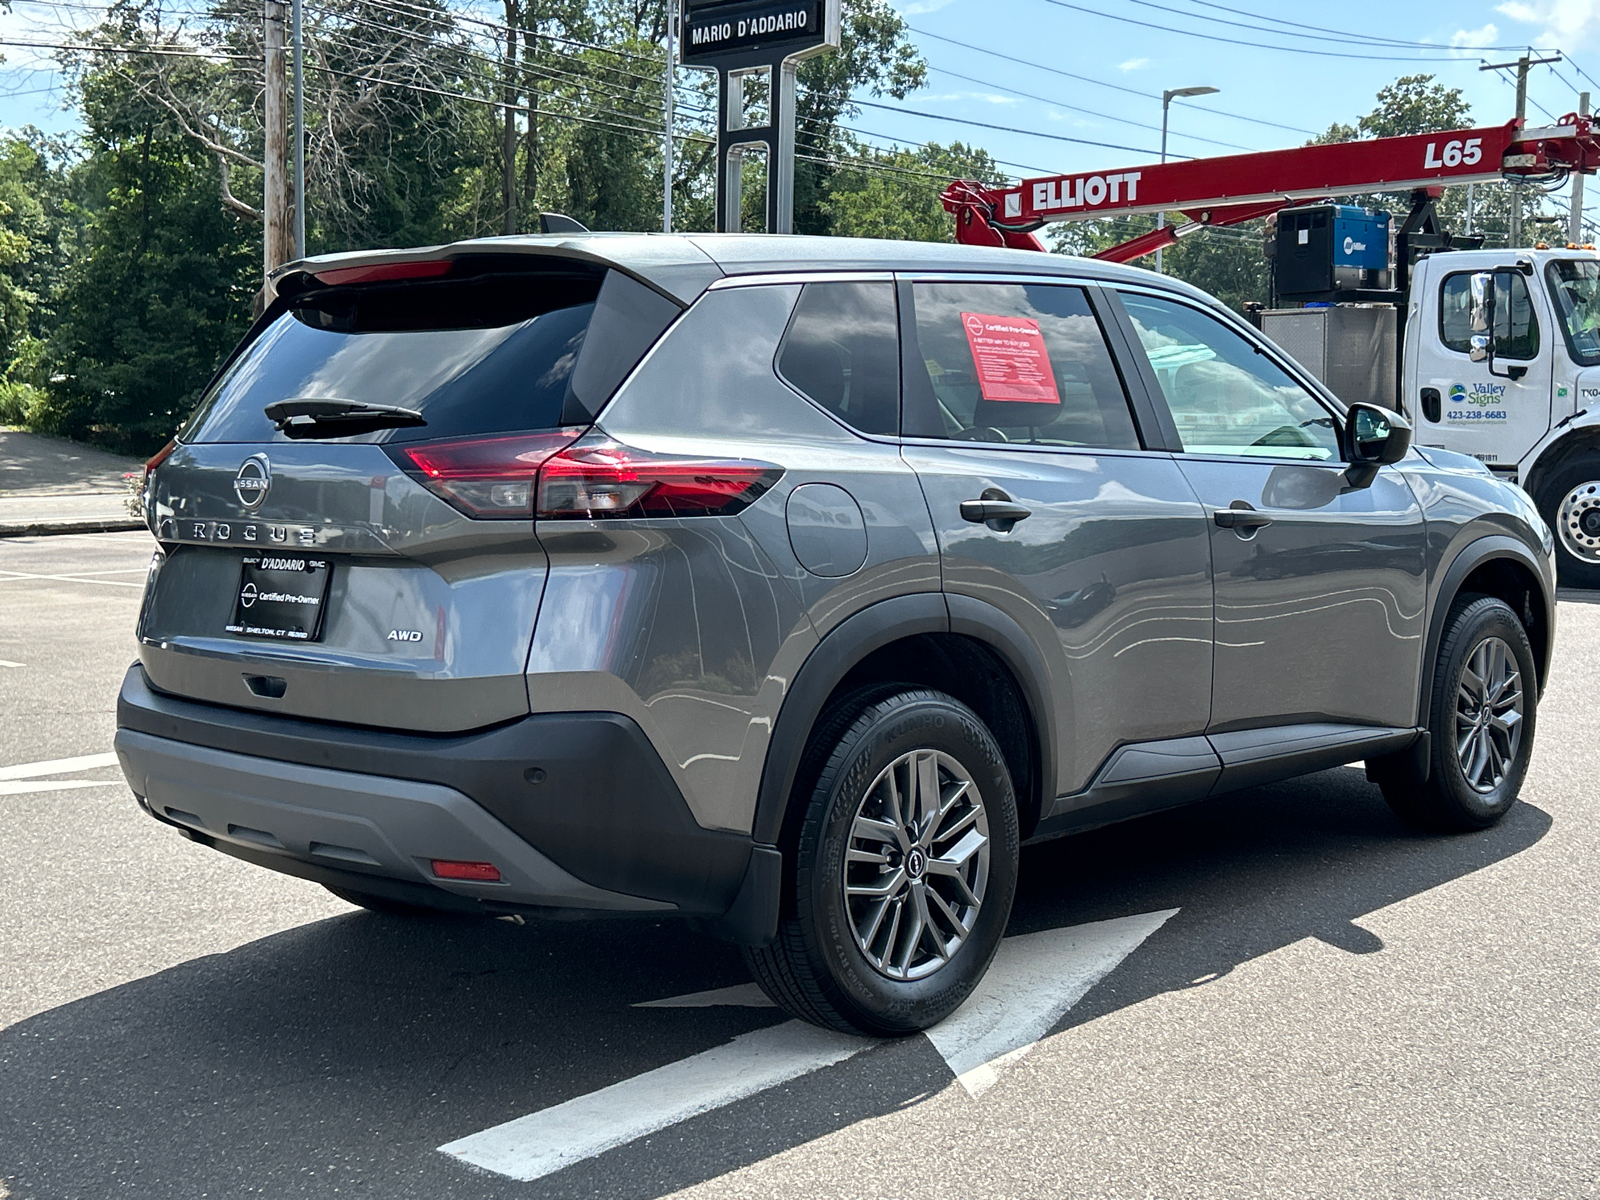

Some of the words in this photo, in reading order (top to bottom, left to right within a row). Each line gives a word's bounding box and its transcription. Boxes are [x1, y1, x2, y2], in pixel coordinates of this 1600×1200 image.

[692, 23, 731, 45] MARIO
[738, 11, 807, 37] D'ADDARIO
[1424, 138, 1482, 169] L65
[1032, 171, 1141, 211] ELLIOTT
[985, 324, 1008, 332] Certified
[1473, 383, 1506, 396] Valley
[1581, 388, 1600, 398] TK0
[1468, 391, 1501, 407] Signs
[1447, 410, 1507, 419] 423-238-6683
[234, 479, 269, 489] NISSAN
[193, 523, 317, 546] ROGUE
[261, 558, 305, 571] D'ADDARIO
[309, 560, 326, 568] GMC
[259, 592, 285, 602] Certified
[246, 626, 275, 636] SHELTON,
[387, 629, 422, 642] AWD
[885, 714, 945, 744] KUMHO
[835, 944, 850, 969] R17
